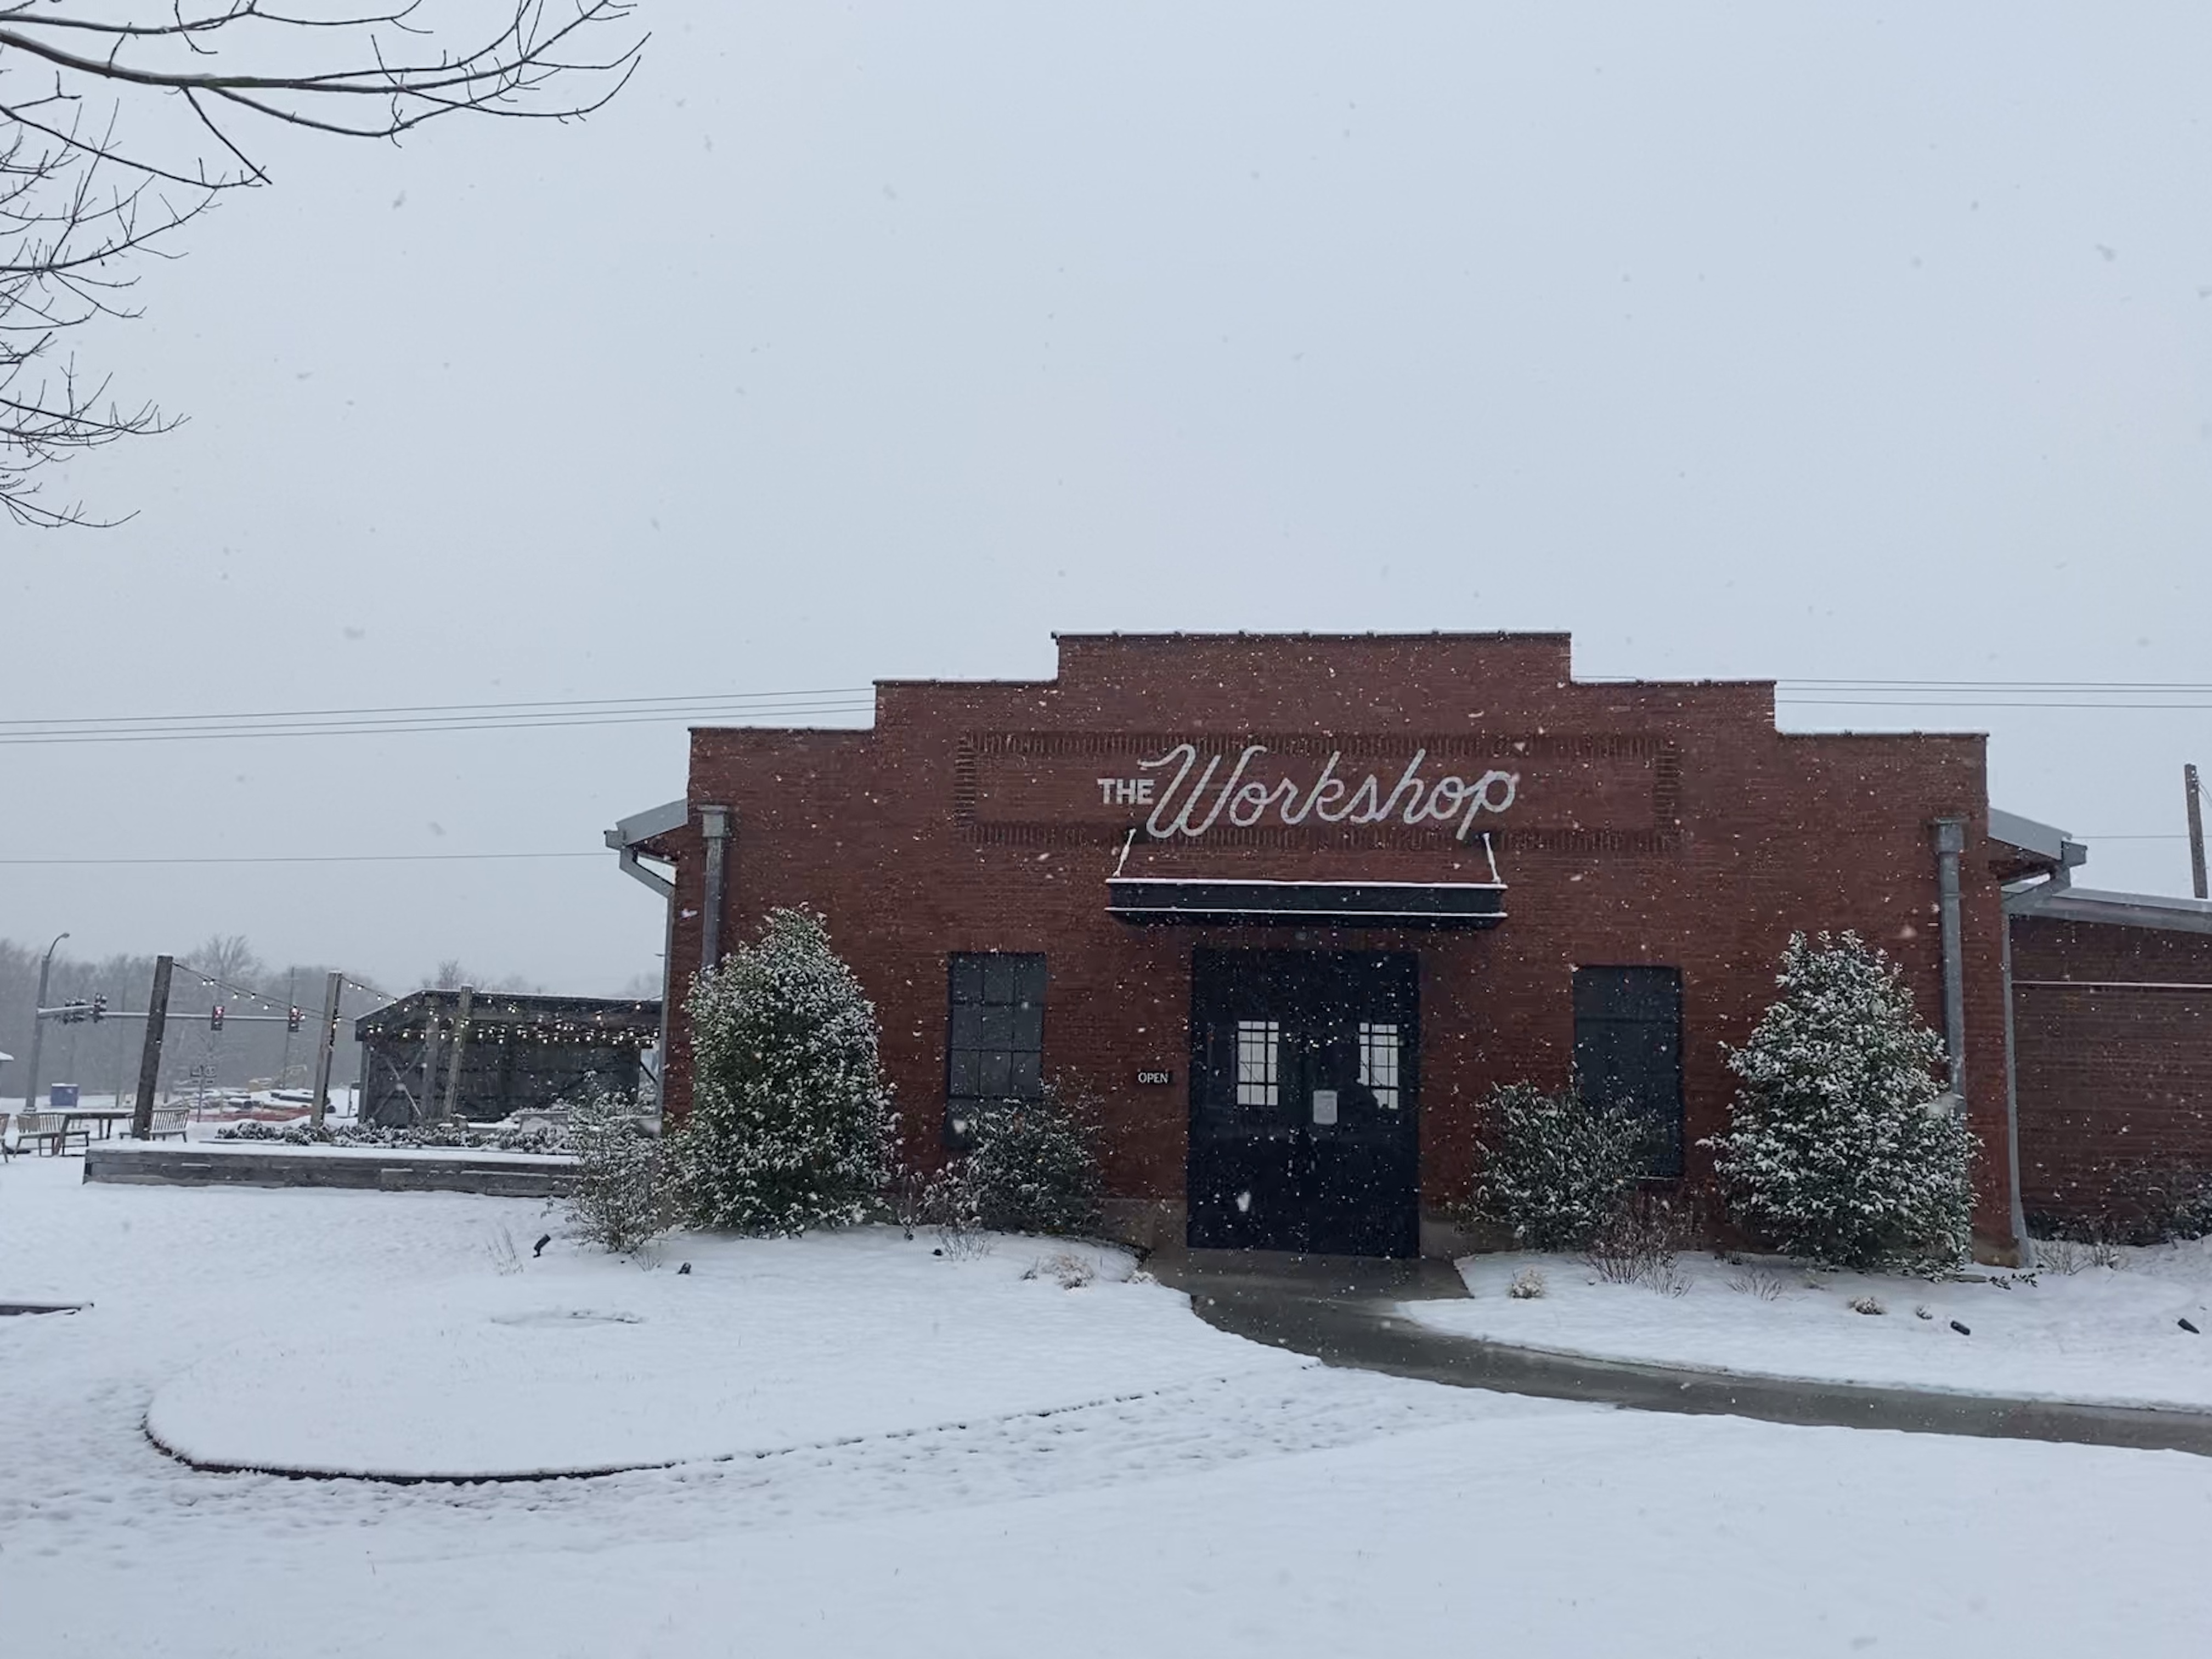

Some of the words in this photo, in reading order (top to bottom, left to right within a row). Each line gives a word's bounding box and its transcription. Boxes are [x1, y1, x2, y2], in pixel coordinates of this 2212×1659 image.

[1097, 777, 1154, 805] THE
[1137, 743, 1517, 840] Workshop
[1138, 1072, 1169, 1084] OPEN
